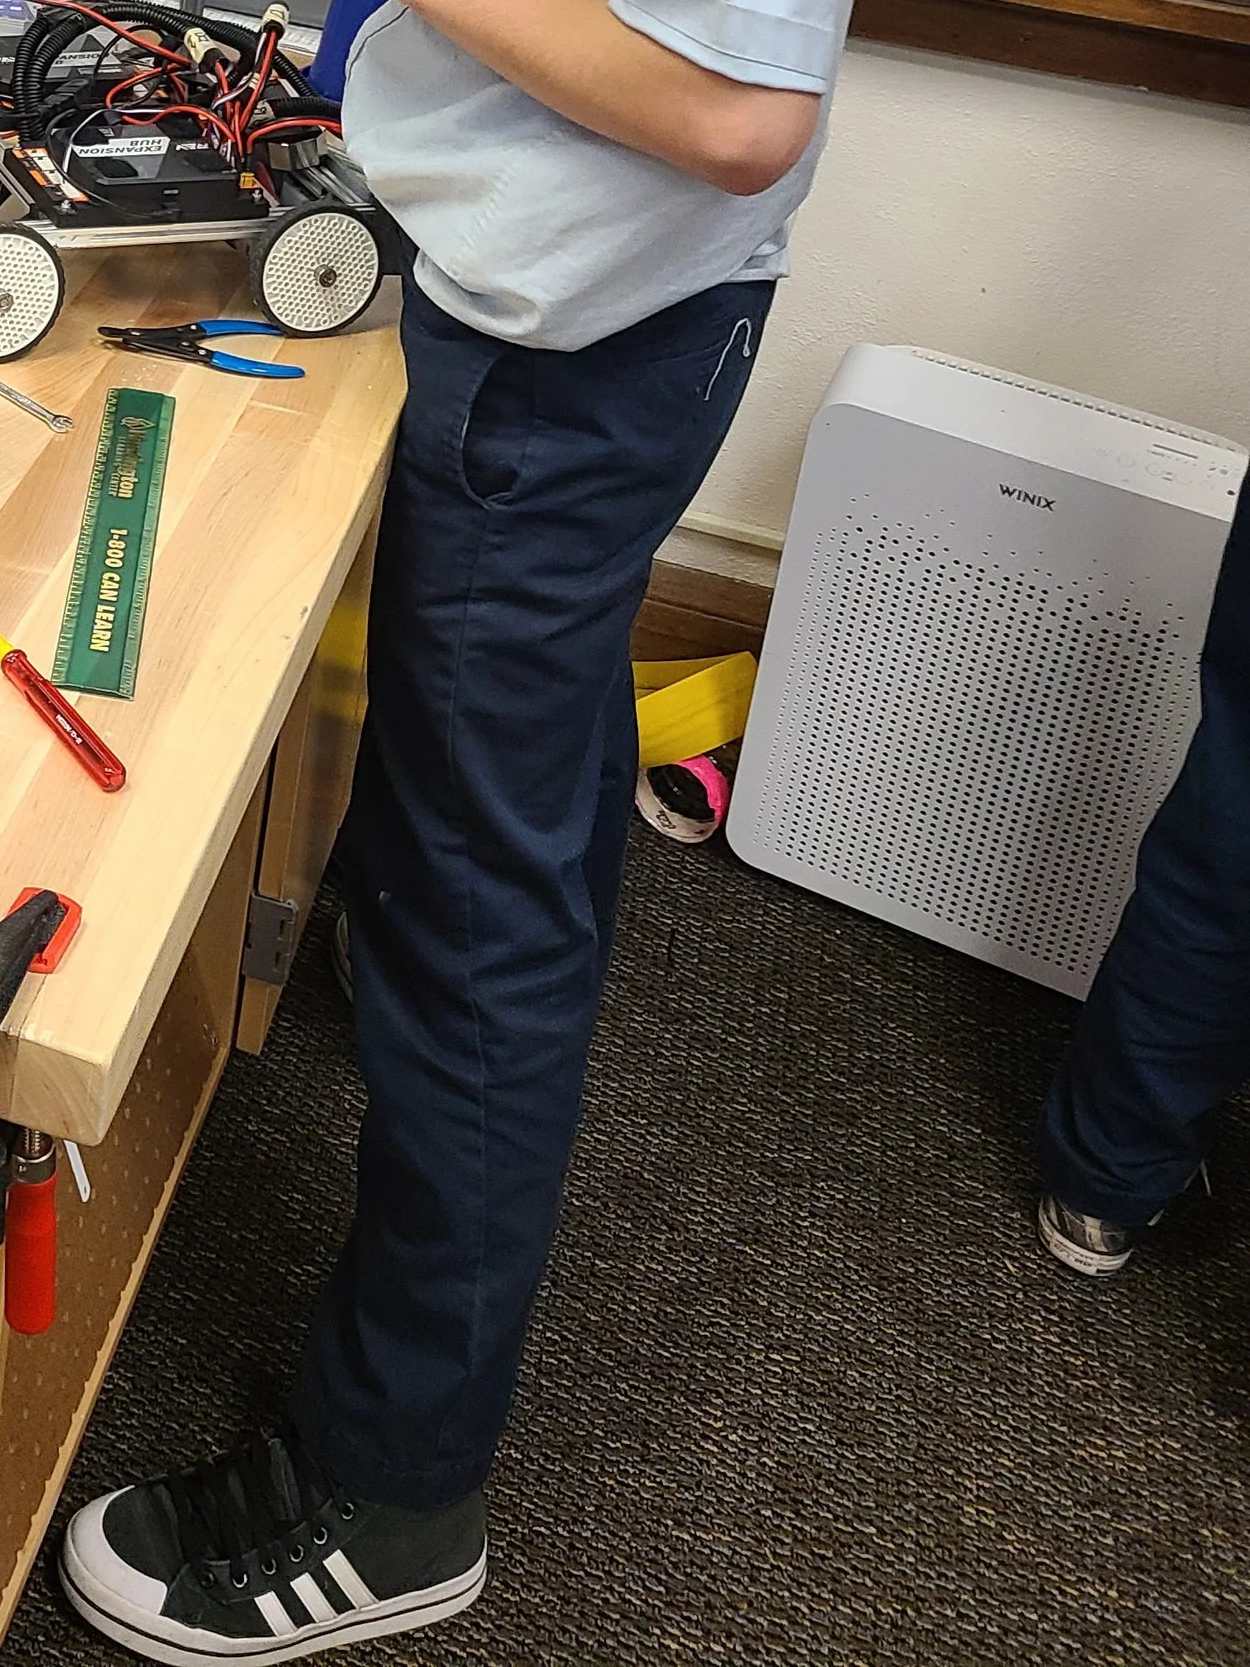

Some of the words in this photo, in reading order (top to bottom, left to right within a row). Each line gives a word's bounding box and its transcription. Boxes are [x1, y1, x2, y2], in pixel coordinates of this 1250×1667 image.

[78, 145, 163, 156] EXPANSION
[129, 138, 163, 147] HUB
[999, 483, 1056, 512] WINIX
[103, 528, 129, 570] 1-800
[98, 570, 121, 605] CAN
[89, 605, 116, 654] LEARN
